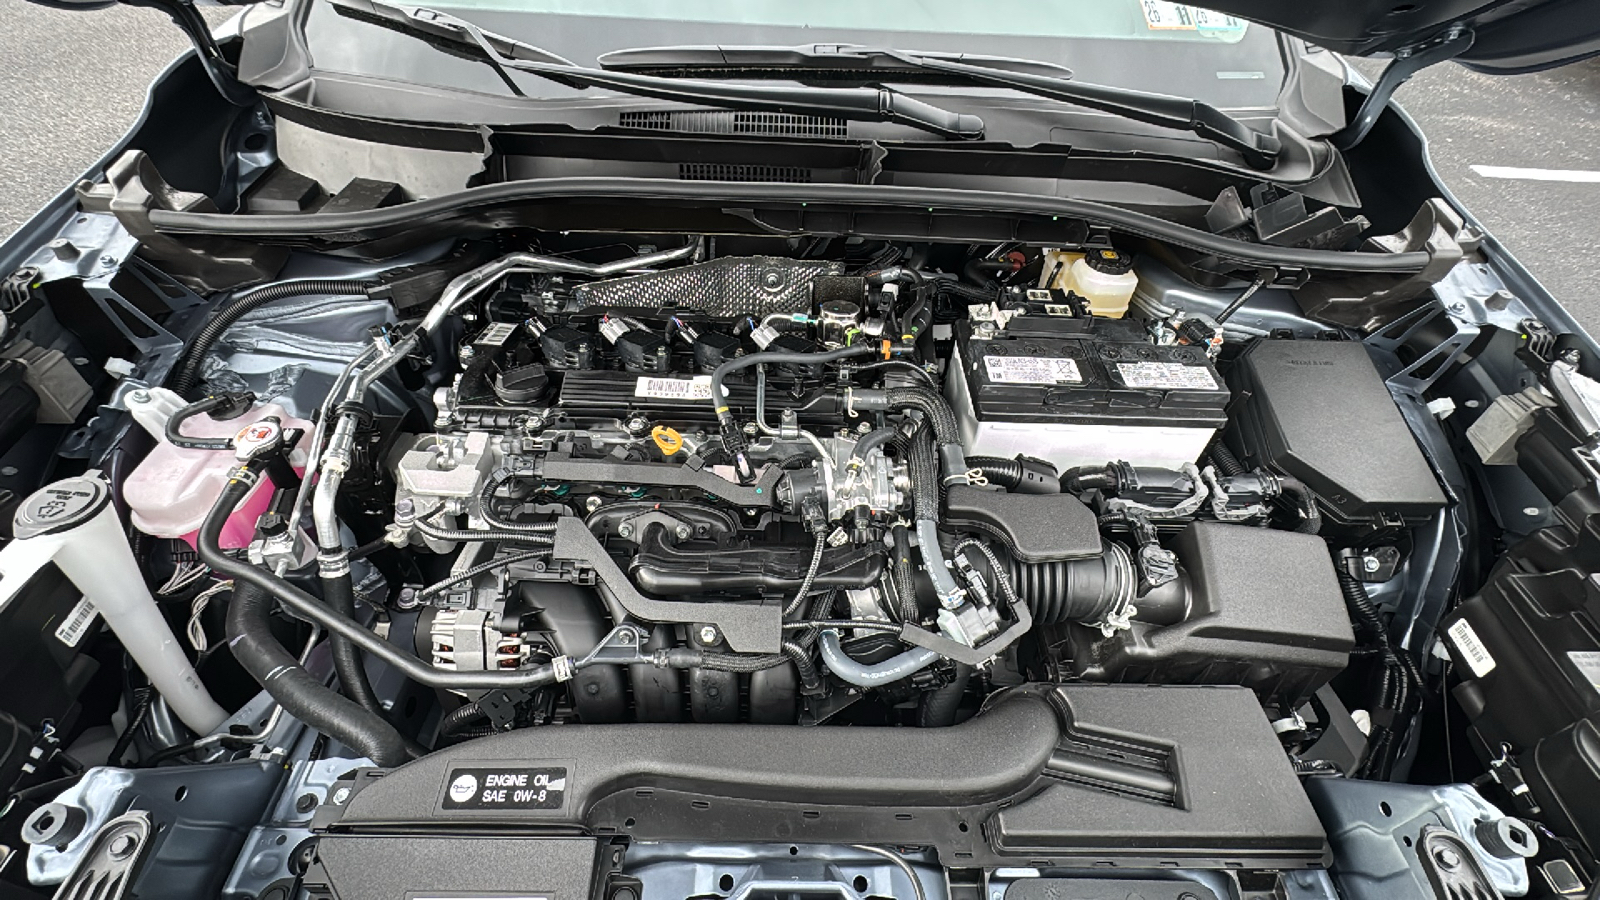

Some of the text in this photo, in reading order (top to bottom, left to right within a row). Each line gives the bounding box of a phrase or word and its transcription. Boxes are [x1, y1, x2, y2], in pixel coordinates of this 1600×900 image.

[485, 774, 553, 787] ENGINE OIL
[482, 790, 547, 803] SAE 0W-8
